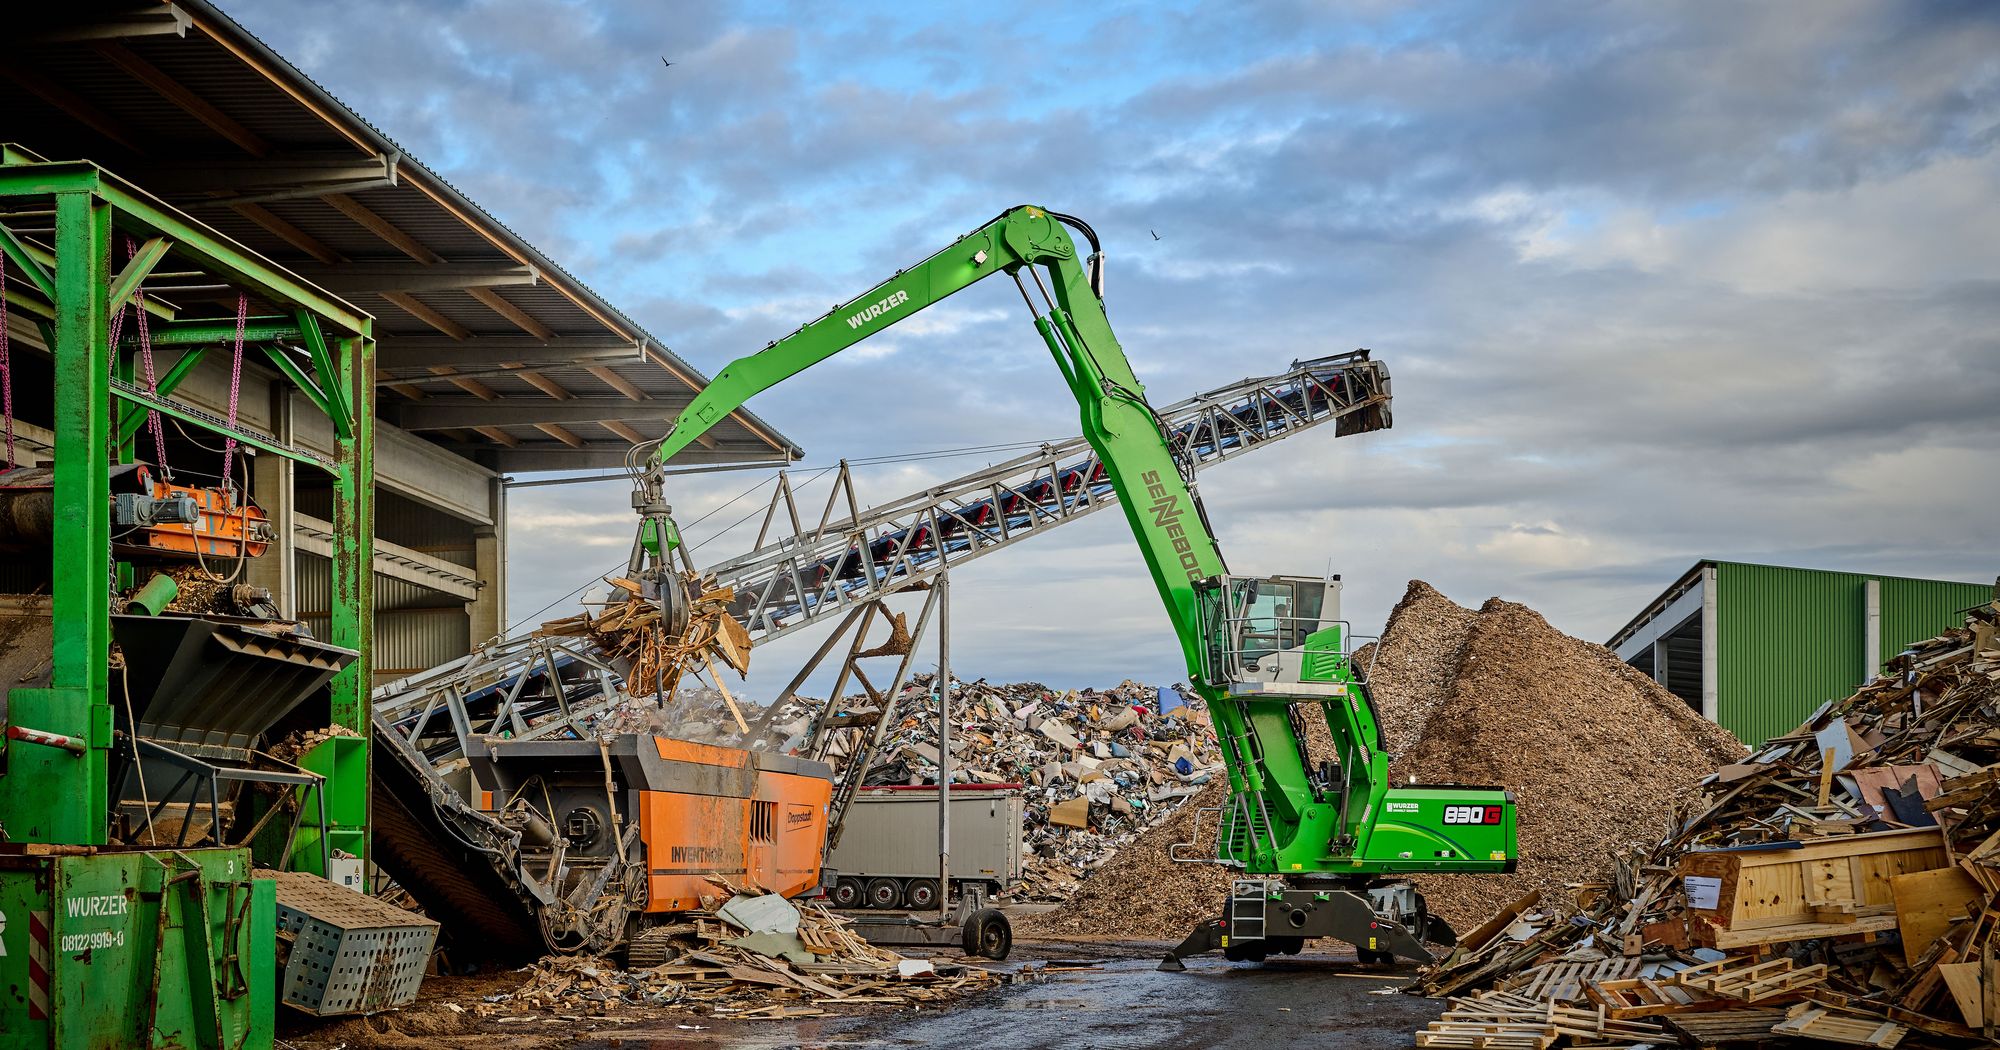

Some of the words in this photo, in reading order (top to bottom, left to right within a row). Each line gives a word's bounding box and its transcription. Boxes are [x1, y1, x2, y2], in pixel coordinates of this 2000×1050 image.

[846, 290, 909, 329] WURZER
[1444, 806, 1501, 824] 830G
[227, 860, 234, 875] 3
[67, 896, 127, 917] WURZER
